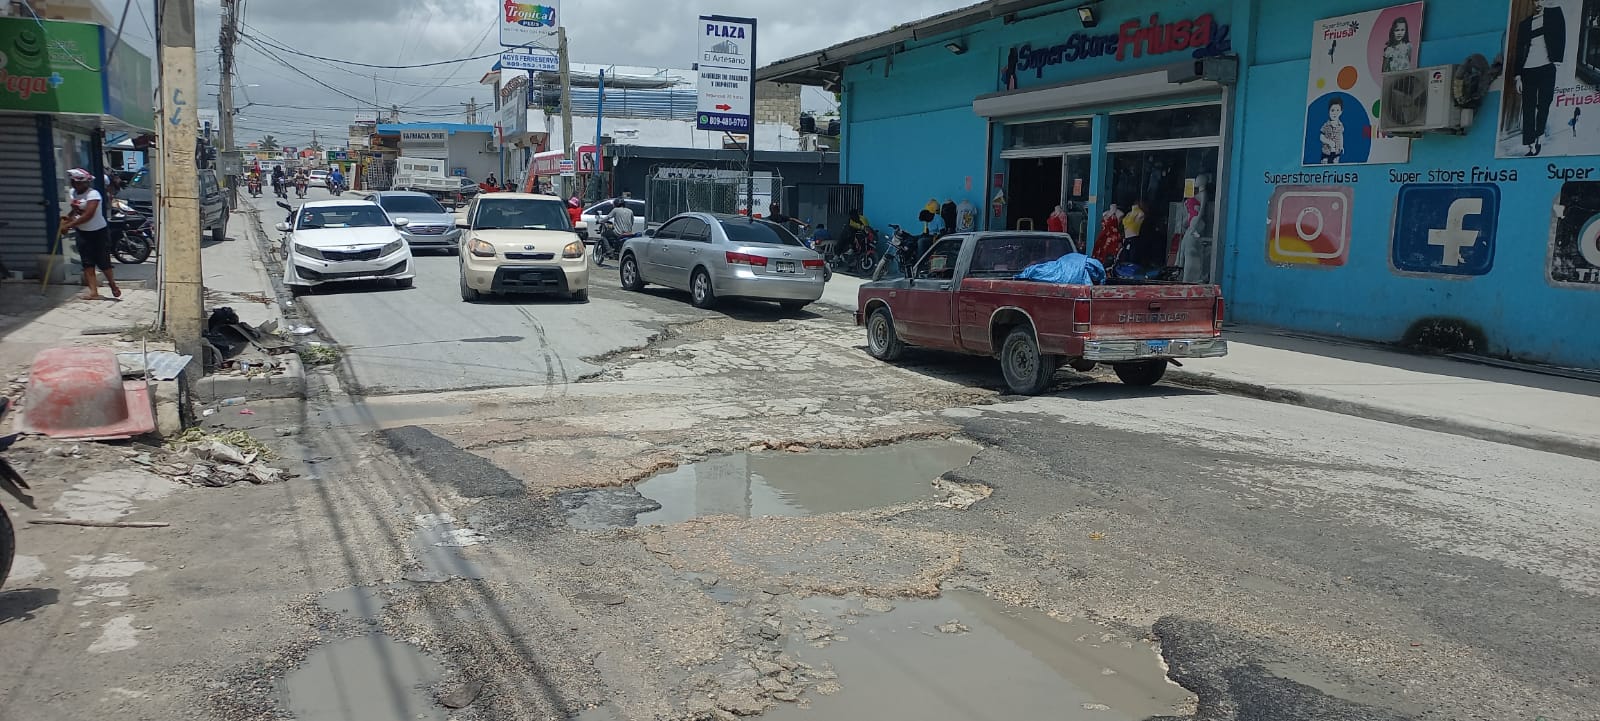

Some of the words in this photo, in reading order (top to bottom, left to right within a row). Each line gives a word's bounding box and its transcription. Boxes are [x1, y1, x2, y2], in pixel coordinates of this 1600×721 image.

[507, 6, 554, 20] Tropical
[706, 23, 745, 39] PLAZA
[1115, 12, 1213, 61] Friusa
[1324, 28, 1354, 40] Friusa
[704, 53, 710, 61] El
[712, 54, 746, 64] Artesano
[1389, 169, 1422, 184] Super
[1547, 163, 1594, 184] Super
[1575, 267, 1600, 281] Ti
[1118, 312, 1188, 323] CHEROLET
